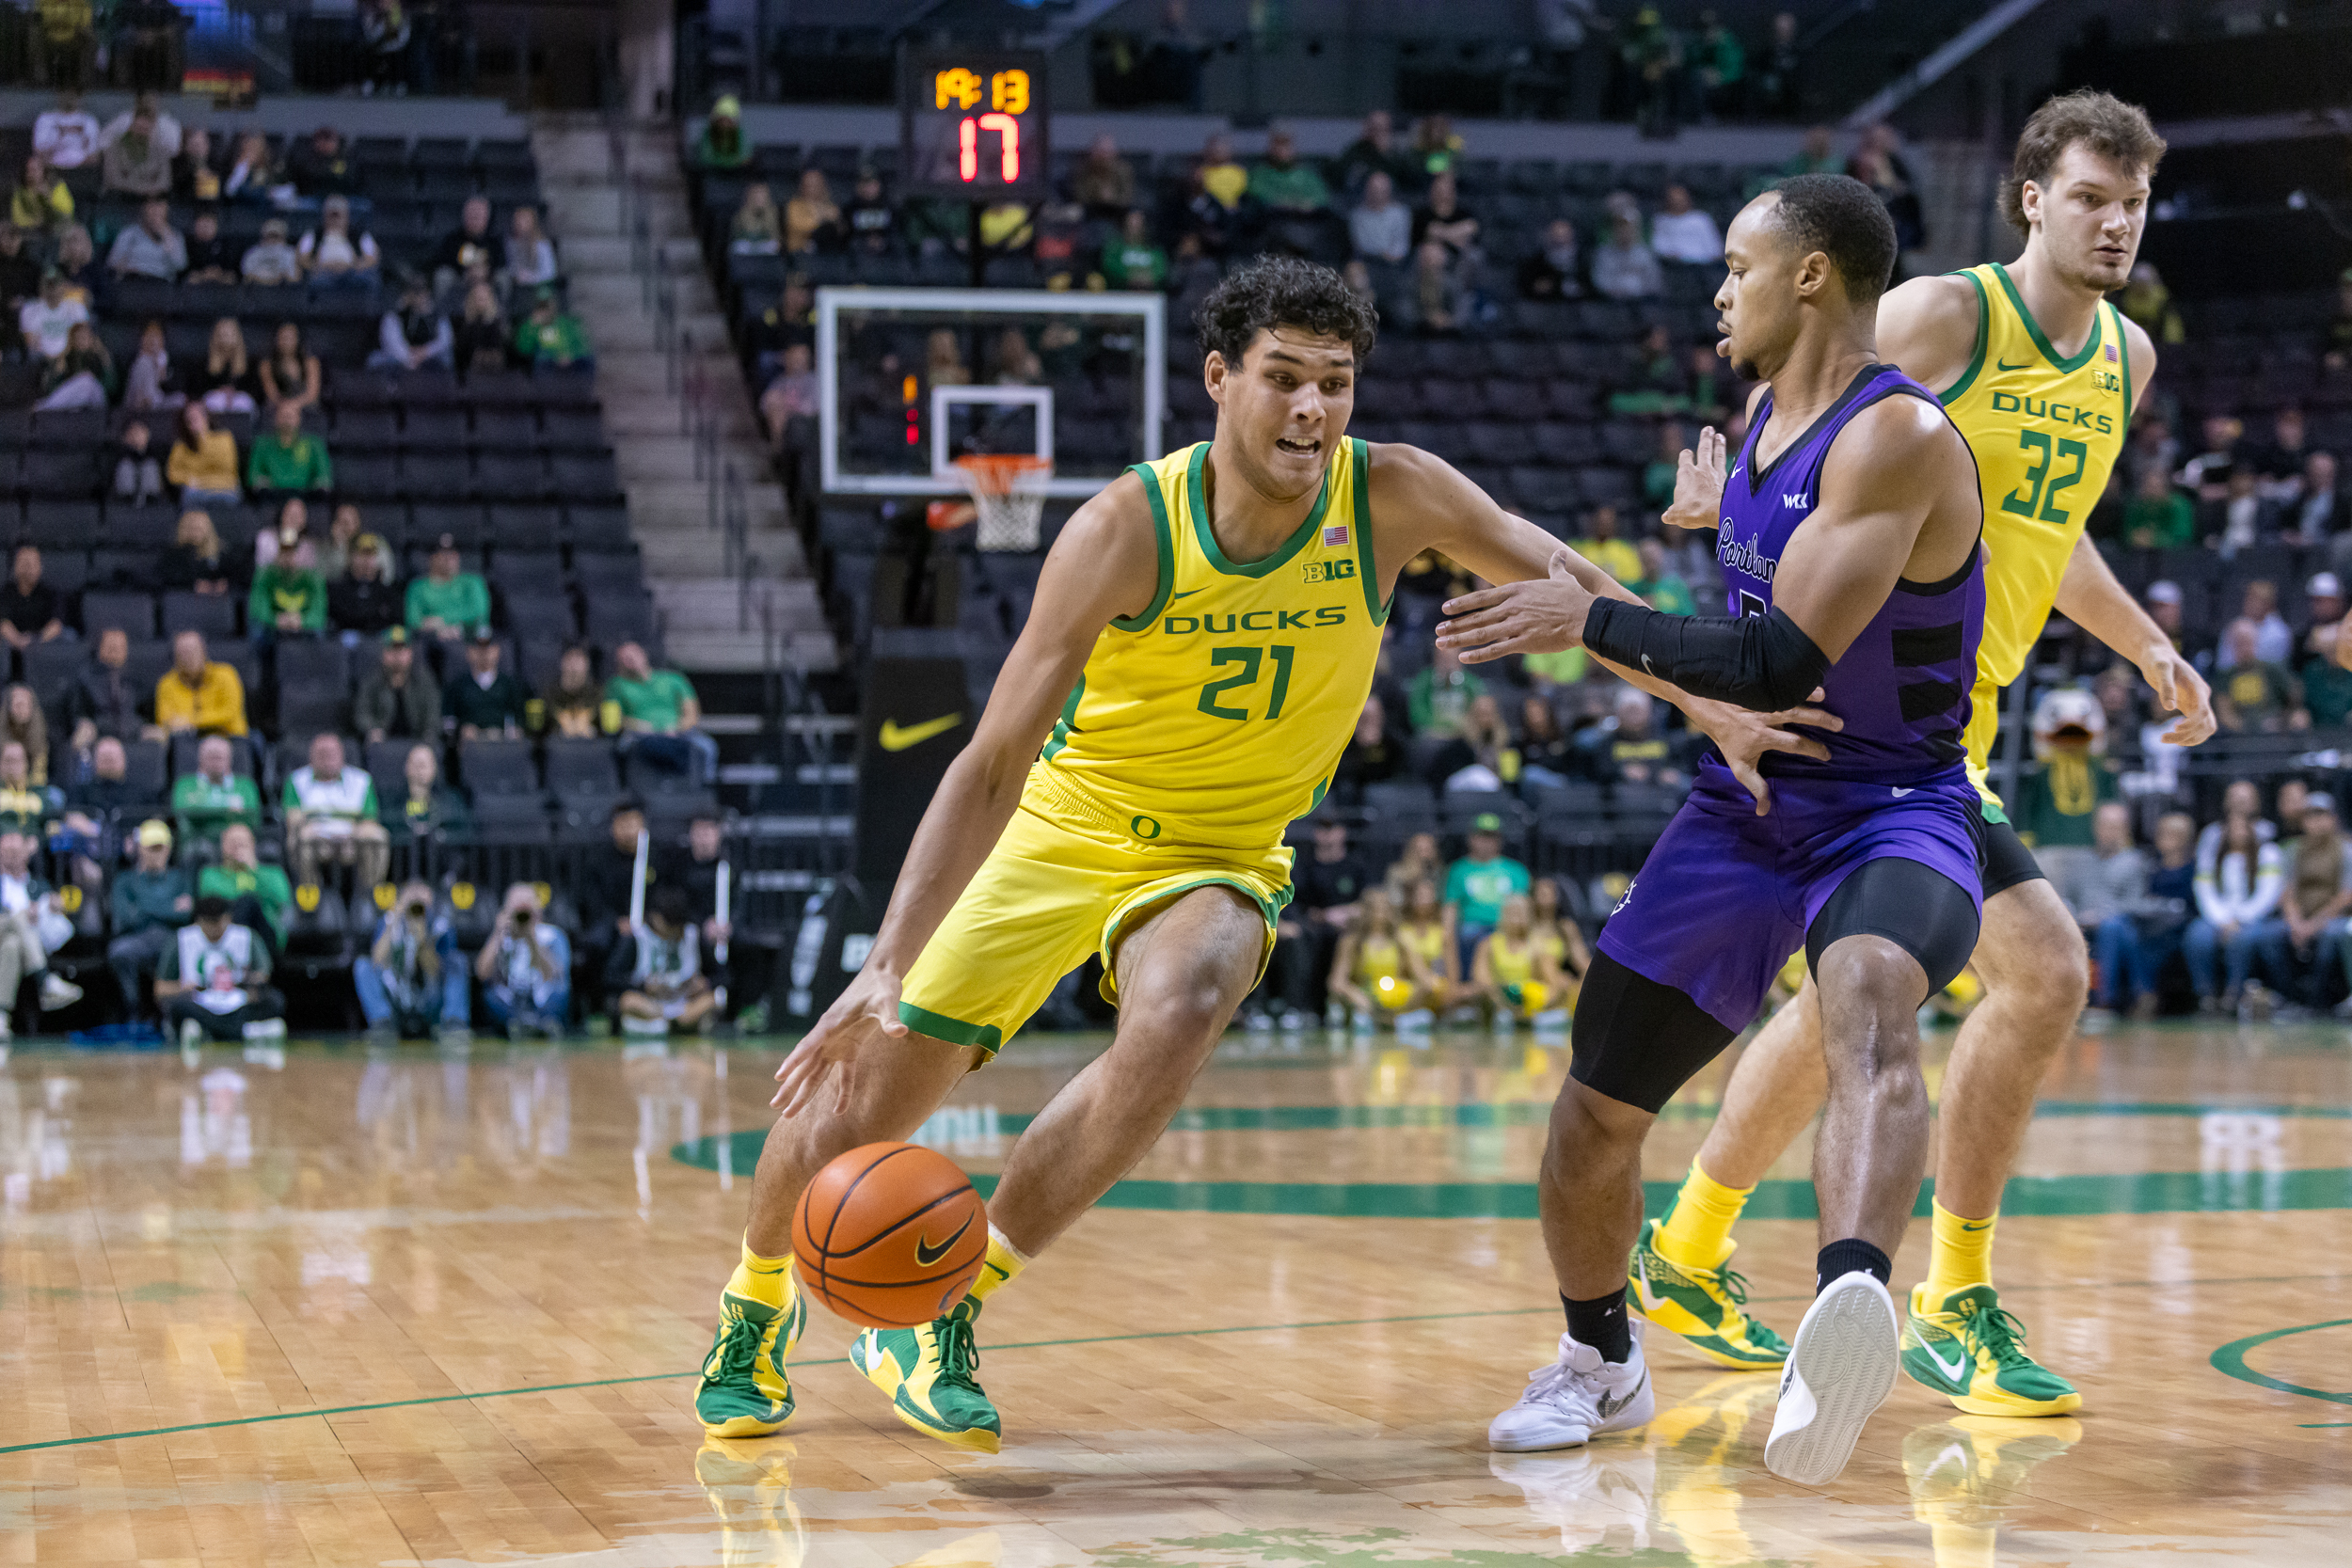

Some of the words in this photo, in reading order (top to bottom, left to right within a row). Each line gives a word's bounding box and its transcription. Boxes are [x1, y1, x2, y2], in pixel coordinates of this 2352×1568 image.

[936, 68, 1029, 115] 19:13
[960, 113, 1020, 183] 17
[1992, 391, 2112, 435] DUCKS
[2000, 429, 2088, 525] 32
[1716, 517, 1778, 584] Portlan
[1165, 606, 1346, 635] DUCKS
[1197, 644, 1295, 721] 21
[1131, 816, 1161, 839] O
